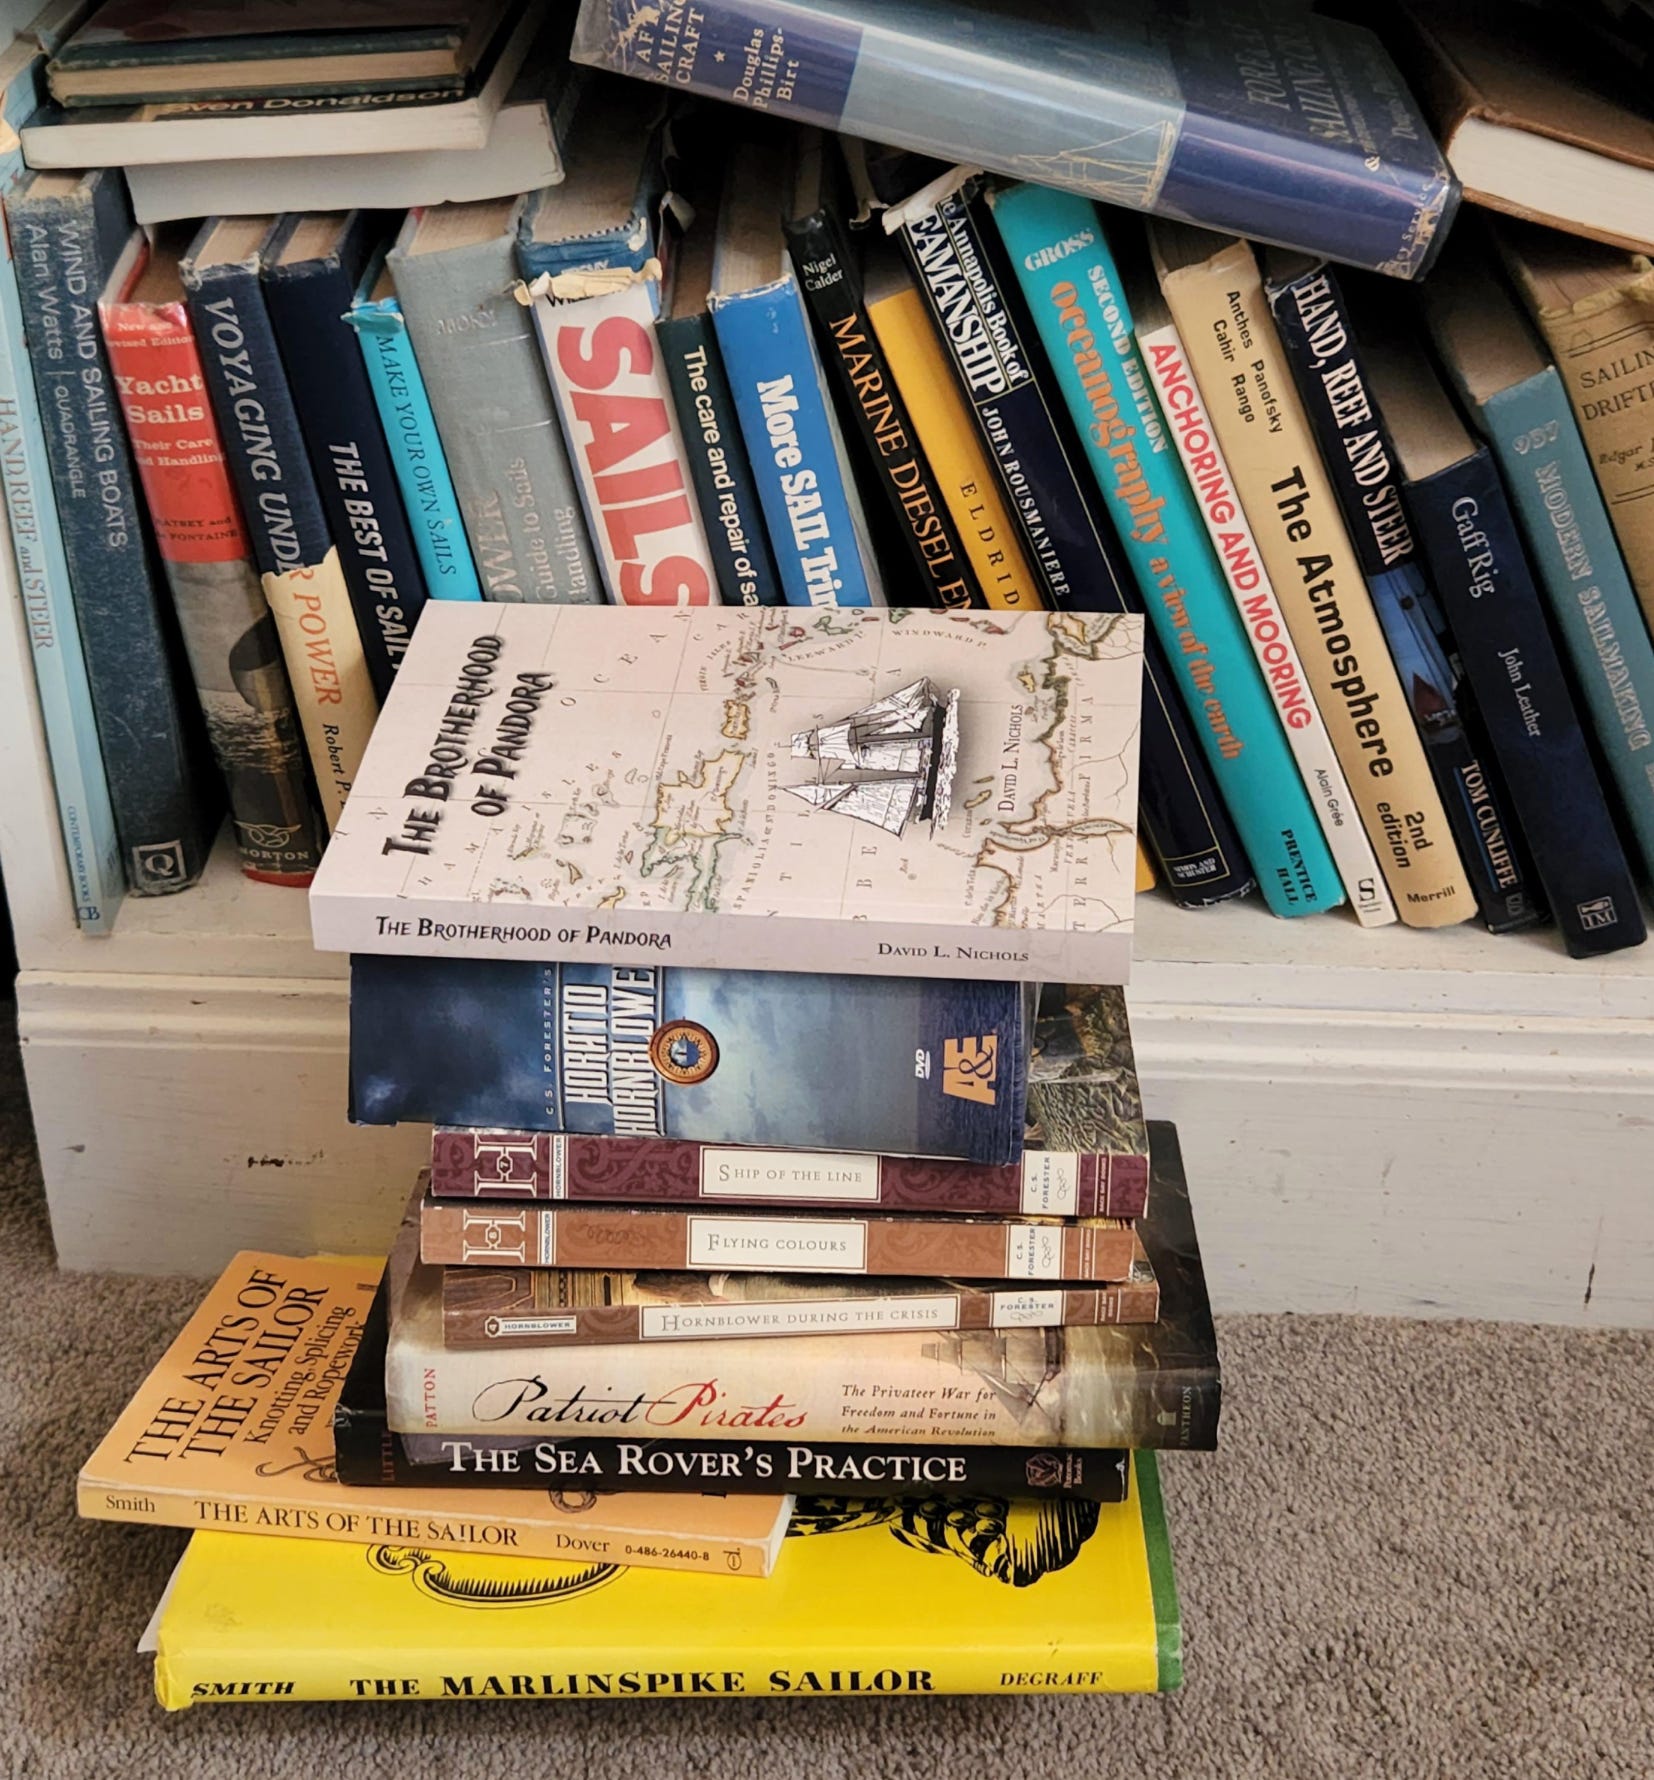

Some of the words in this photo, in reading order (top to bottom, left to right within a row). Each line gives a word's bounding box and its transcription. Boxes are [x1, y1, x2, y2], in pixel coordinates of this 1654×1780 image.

[675, 7, 705, 84] CRAFT
[733, 27, 765, 102] Douglas
[752, 27, 785, 109] Phillips-
[776, 59, 800, 101] Birt
[57, 221, 88, 294] WIND
[803, 253, 837, 276] Nigel
[1024, 229, 1095, 271] GROSS
[25, 224, 48, 278] Alan
[39, 286, 63, 360] Watts
[804, 269, 845, 292] Calder
[947, 218, 998, 314] Annapolis
[986, 309, 1021, 364] Book
[1006, 360, 1030, 384] of
[71, 304, 97, 359] AND
[1293, 274, 1347, 369] HAND,
[115, 374, 205, 396] Yacht
[376, 334, 409, 398] MAKE
[683, 345, 708, 391] The
[1087, 265, 1132, 355] SECOND
[1121, 355, 1169, 454] EDITION
[1213, 319, 1236, 363] Cahir
[1231, 373, 1256, 424] Rango
[1226, 290, 1254, 350] Anthes
[1251, 359, 1283, 434] Panofsky
[82, 368, 115, 462] SAILING
[127, 405, 205, 424] Sails
[695, 395, 720, 444] care
[1051, 281, 1168, 544] Oceanography
[1321, 358, 1373, 429] REEF
[54, 385, 86, 499] QUADRANGLE
[176, 438, 213, 450] Care
[396, 402, 426, 463] YOUR
[557, 316, 711, 606] SAILS
[757, 374, 802, 469] More
[780, 469, 830, 551] SAIL
[829, 312, 908, 456] MARINE
[889, 459, 955, 579] DIESEL
[1343, 428, 1390, 486] AND
[329, 441, 369, 493] THE
[415, 466, 441, 513] OWN
[707, 447, 735, 490] and
[9, 481, 38, 542] REEF
[100, 471, 128, 548] BOATS
[205, 297, 282, 481] VOYAGING
[294, 592, 342, 706] POWER
[344, 499, 389, 563] BEST
[717, 492, 750, 553] repair
[982, 406, 1014, 457] JOHN
[1003, 460, 1071, 597] ROUSMANIERE
[1362, 484, 1415, 566] STEER
[1452, 496, 1489, 552] Gaff
[427, 519, 457, 576] SAILS
[961, 482, 1021, 606] ELDRID
[1149, 344, 1236, 524] ANCHORING
[1217, 532, 1260, 591] AND
[1243, 593, 1313, 730] MOORING
[1150, 557, 1169, 575] a
[365, 568, 399, 608] OF
[734, 557, 757, 578] of
[1468, 552, 1499, 599] Rig
[23, 577, 54, 649] STEER
[1157, 573, 1191, 629] view
[1271, 465, 1313, 543] The
[1296, 554, 1394, 778] Atmosphere
[1535, 459, 1593, 581] MODERN
[1578, 585, 1652, 752] SAILMAKING
[1178, 631, 1209, 656] of
[1189, 658, 1216, 695] the
[1498, 647, 1522, 684] John
[1514, 684, 1542, 738] Leather
[402, 634, 505, 802] BROTHERHOOD
[471, 671, 556, 781] PANDORA
[1003, 704, 1024, 755] NICHOLS
[1202, 698, 1245, 760] earth
[322, 723, 346, 776] Robert
[1006, 757, 1019, 771] L.
[470, 784, 510, 817] OF
[998, 774, 1017, 813] DAVID
[1314, 768, 1333, 798] Alain
[1326, 798, 1345, 827] Grée
[382, 807, 445, 857] THE
[1377, 802, 1411, 868] edition
[1404, 811, 1434, 851] 2nd
[1461, 759, 1487, 803] TOM
[1476, 803, 1518, 889] CUNLIFFE
[1276, 868, 1299, 906] HALL
[1281, 829, 1318, 902] PRENTICE
[1407, 885, 1456, 904] Merrill
[376, 915, 412, 936] THE
[418, 916, 552, 944] BROTHERHOOD
[558, 928, 581, 943] OF
[586, 925, 672, 950] PANDORA
[878, 942, 928, 957] DAVID
[933, 945, 951, 959] L.
[957, 946, 1029, 962] NICHOLS
[543, 968, 552, 1073] FORESTER'S
[563, 984, 611, 1104] HORATIO
[943, 1028, 998, 1106] A&E
[555, 1137, 563, 1198] HORNBLOWER
[719, 1164, 760, 1182] SHIP
[766, 1169, 786, 1180] OF
[792, 1170, 821, 1181] THE
[828, 1172, 862, 1183] LINE
[1042, 1157, 1051, 1209] FORESTER
[707, 1232, 769, 1251] FLYING
[776, 1239, 847, 1252] COLOURS
[1028, 1228, 1036, 1276] FORESTER
[296, 1306, 357, 1368] Splicing
[504, 1321, 571, 1330] HORNBLOWER
[661, 1314, 780, 1331] HORNBLOWER
[787, 1311, 849, 1324] DURING
[855, 1310, 885, 1321] THE
[890, 1308, 939, 1320] CRISIS
[123, 1397, 206, 1464] THE
[182, 1314, 260, 1392] ARTS
[237, 1268, 288, 1309] OF
[178, 1394, 258, 1458] THE
[232, 1286, 329, 1390] SAILOR
[288, 1400, 319, 1435] and
[304, 1321, 364, 1401] Ropework
[841, 1384, 867, 1397] The
[872, 1384, 936, 1399] Privateer
[941, 1387, 970, 1400] War
[976, 1388, 997, 1402] for
[424, 1368, 437, 1428] PATTON
[472, 1375, 677, 1424] Patriot
[645, 1377, 809, 1428] Pirates
[841, 1406, 896, 1418] Freedom
[900, 1408, 924, 1419] and
[929, 1408, 979, 1420] Fortune
[983, 1409, 996, 1420] in
[841, 1425, 859, 1434] the
[864, 1425, 926, 1436] American
[931, 1426, 996, 1437] Revolution
[441, 1441, 521, 1473] THE
[535, 1443, 603, 1475] SEA
[617, 1443, 773, 1478] ROVER'S
[786, 1446, 967, 1482] PRACTICE
[105, 1495, 156, 1513] Smith
[194, 1501, 249, 1524] THE
[256, 1507, 319, 1529] ARTS
[326, 1512, 359, 1532] OF
[365, 1515, 421, 1539] THE
[427, 1520, 519, 1546] SAILOR
[555, 1533, 610, 1553] Dover
[625, 1543, 710, 1562] 0-486-26440-8
[190, 1681, 296, 1699] SMITH
[350, 1678, 421, 1697] THE
[440, 1670, 746, 1698] MARLINSPIKE
[768, 1669, 936, 1693] SAILOR
[1000, 1671, 1104, 1687] DEGRAFF
